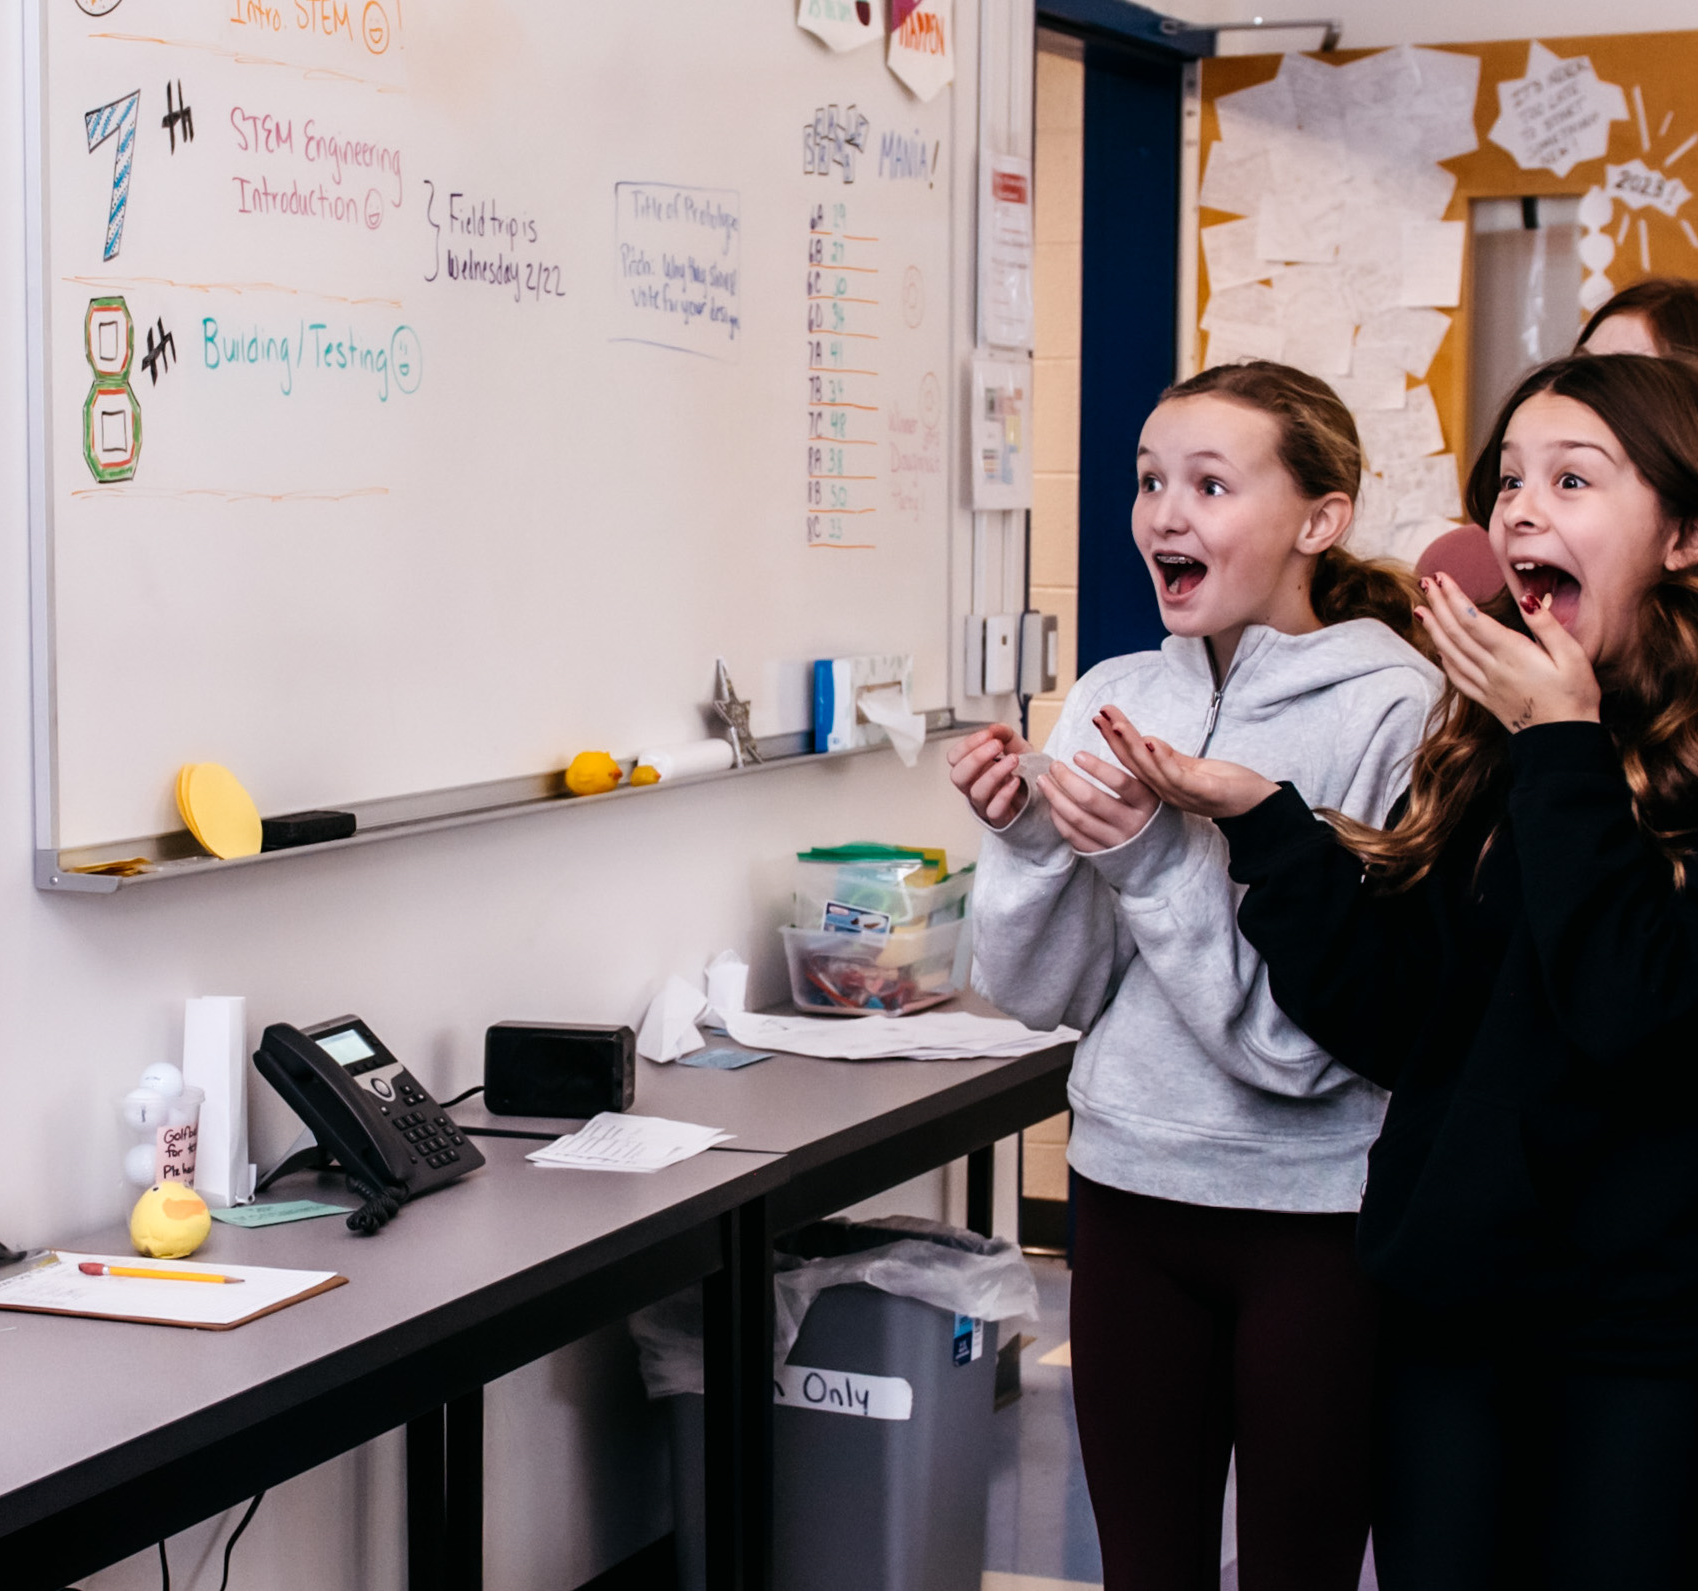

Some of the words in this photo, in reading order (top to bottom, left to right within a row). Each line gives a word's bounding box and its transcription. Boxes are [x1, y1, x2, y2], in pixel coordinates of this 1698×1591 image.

[296, 0, 353, 40] STEM
[230, 106, 294, 154] STEM
[304, 119, 403, 208] Engineering
[232, 176, 359, 224] Introduction
[450, 193, 485, 237] Field
[490, 198, 518, 252] trip
[522, 210, 538, 243] is
[526, 261, 566, 302] 2/22
[808, 411, 823, 437] 7C
[165, 1143, 183, 1158] for
[804, 1372, 869, 1416] Only
